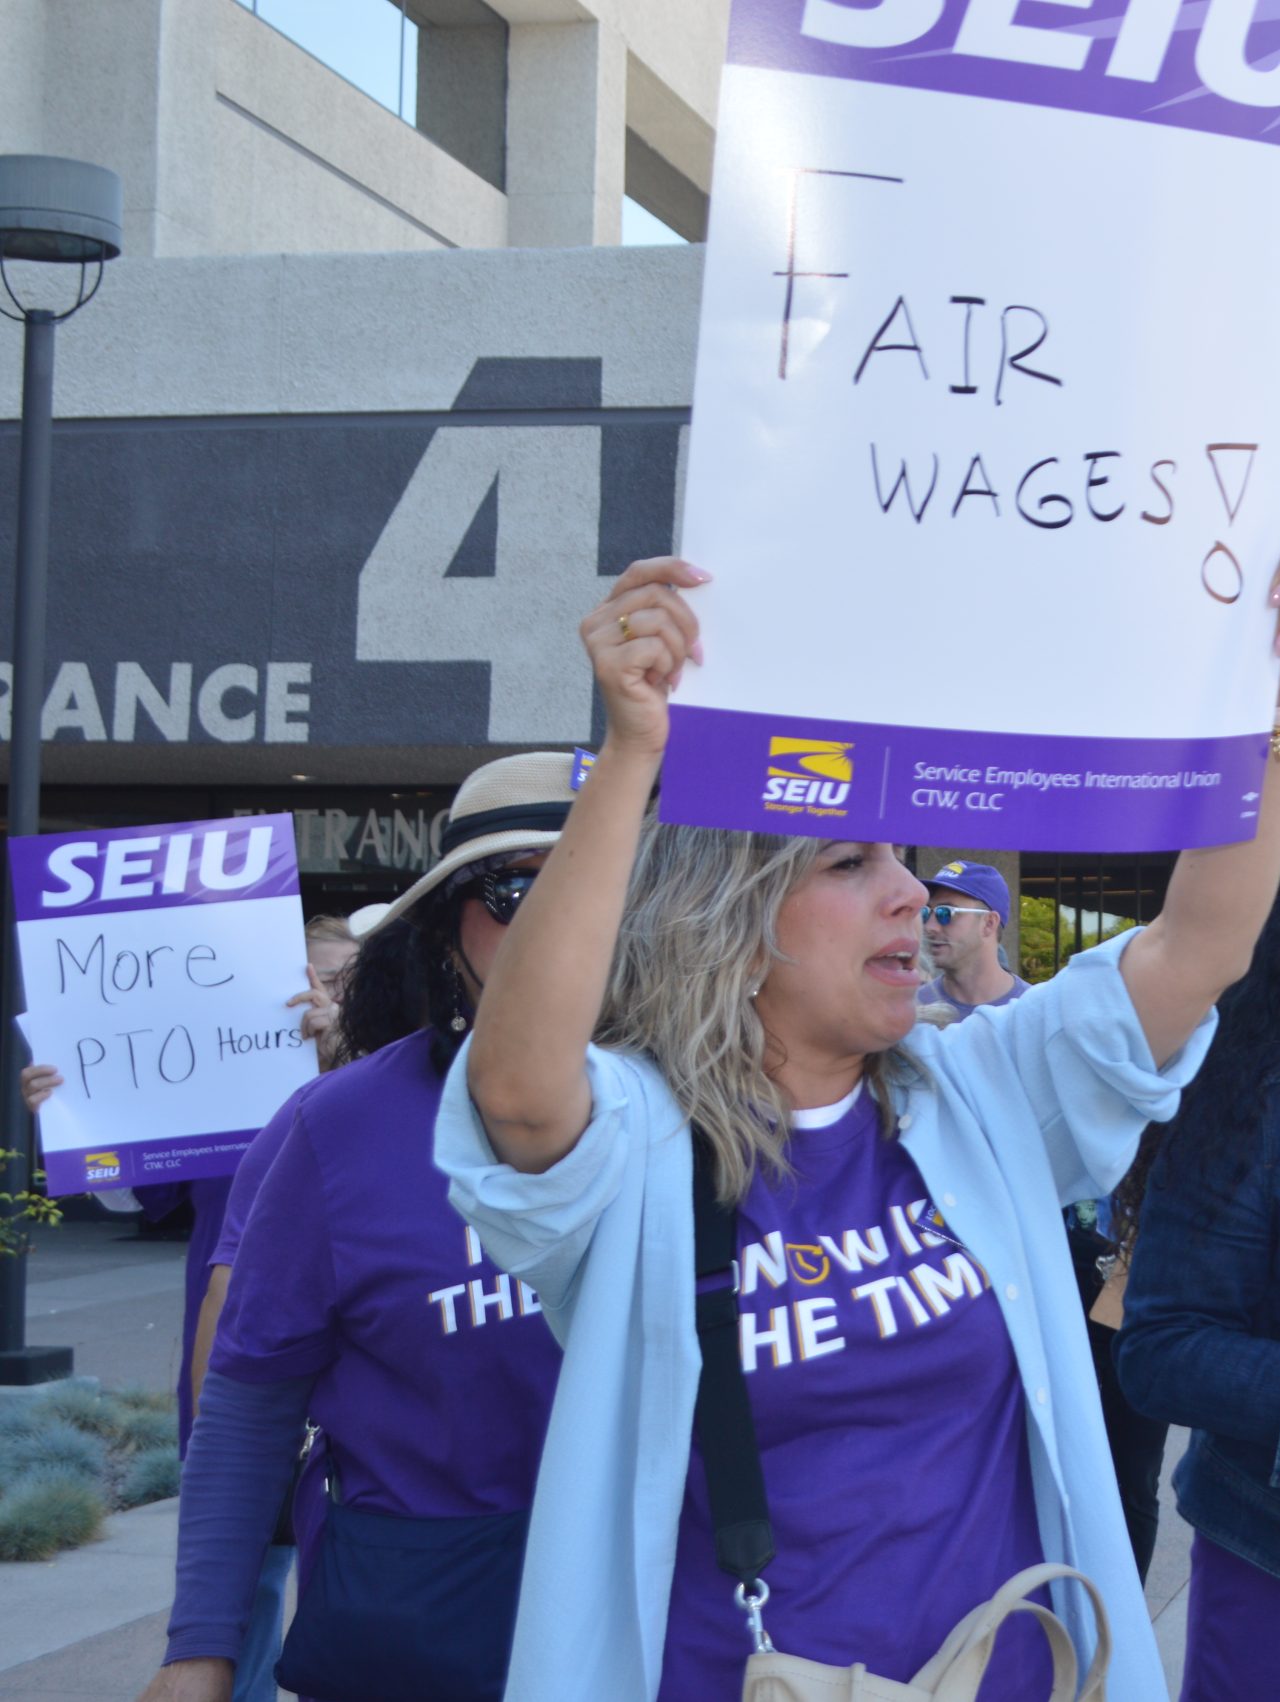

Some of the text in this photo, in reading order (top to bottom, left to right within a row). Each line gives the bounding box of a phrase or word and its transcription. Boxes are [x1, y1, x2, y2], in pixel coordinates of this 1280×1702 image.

[772, 167, 1063, 407] FAIR
[355, 356, 626, 742] 4
[0, 661, 313, 742] ANCE
[762, 777, 850, 806] SEIU
[763, 801, 848, 817] Stronger Together
[911, 788, 1005, 810] CTW, CLC
[913, 761, 1221, 792] Service Employees International Union
[41, 826, 273, 909] SEIU
[56, 933, 235, 1006] More
[76, 1024, 304, 1100] PTO Hours
[86, 1166, 121, 1180] SEIU
[143, 1150, 170, 1161] Service
[171, 1146, 213, 1158] Employees
[852, 1252, 990, 1340] TIM
